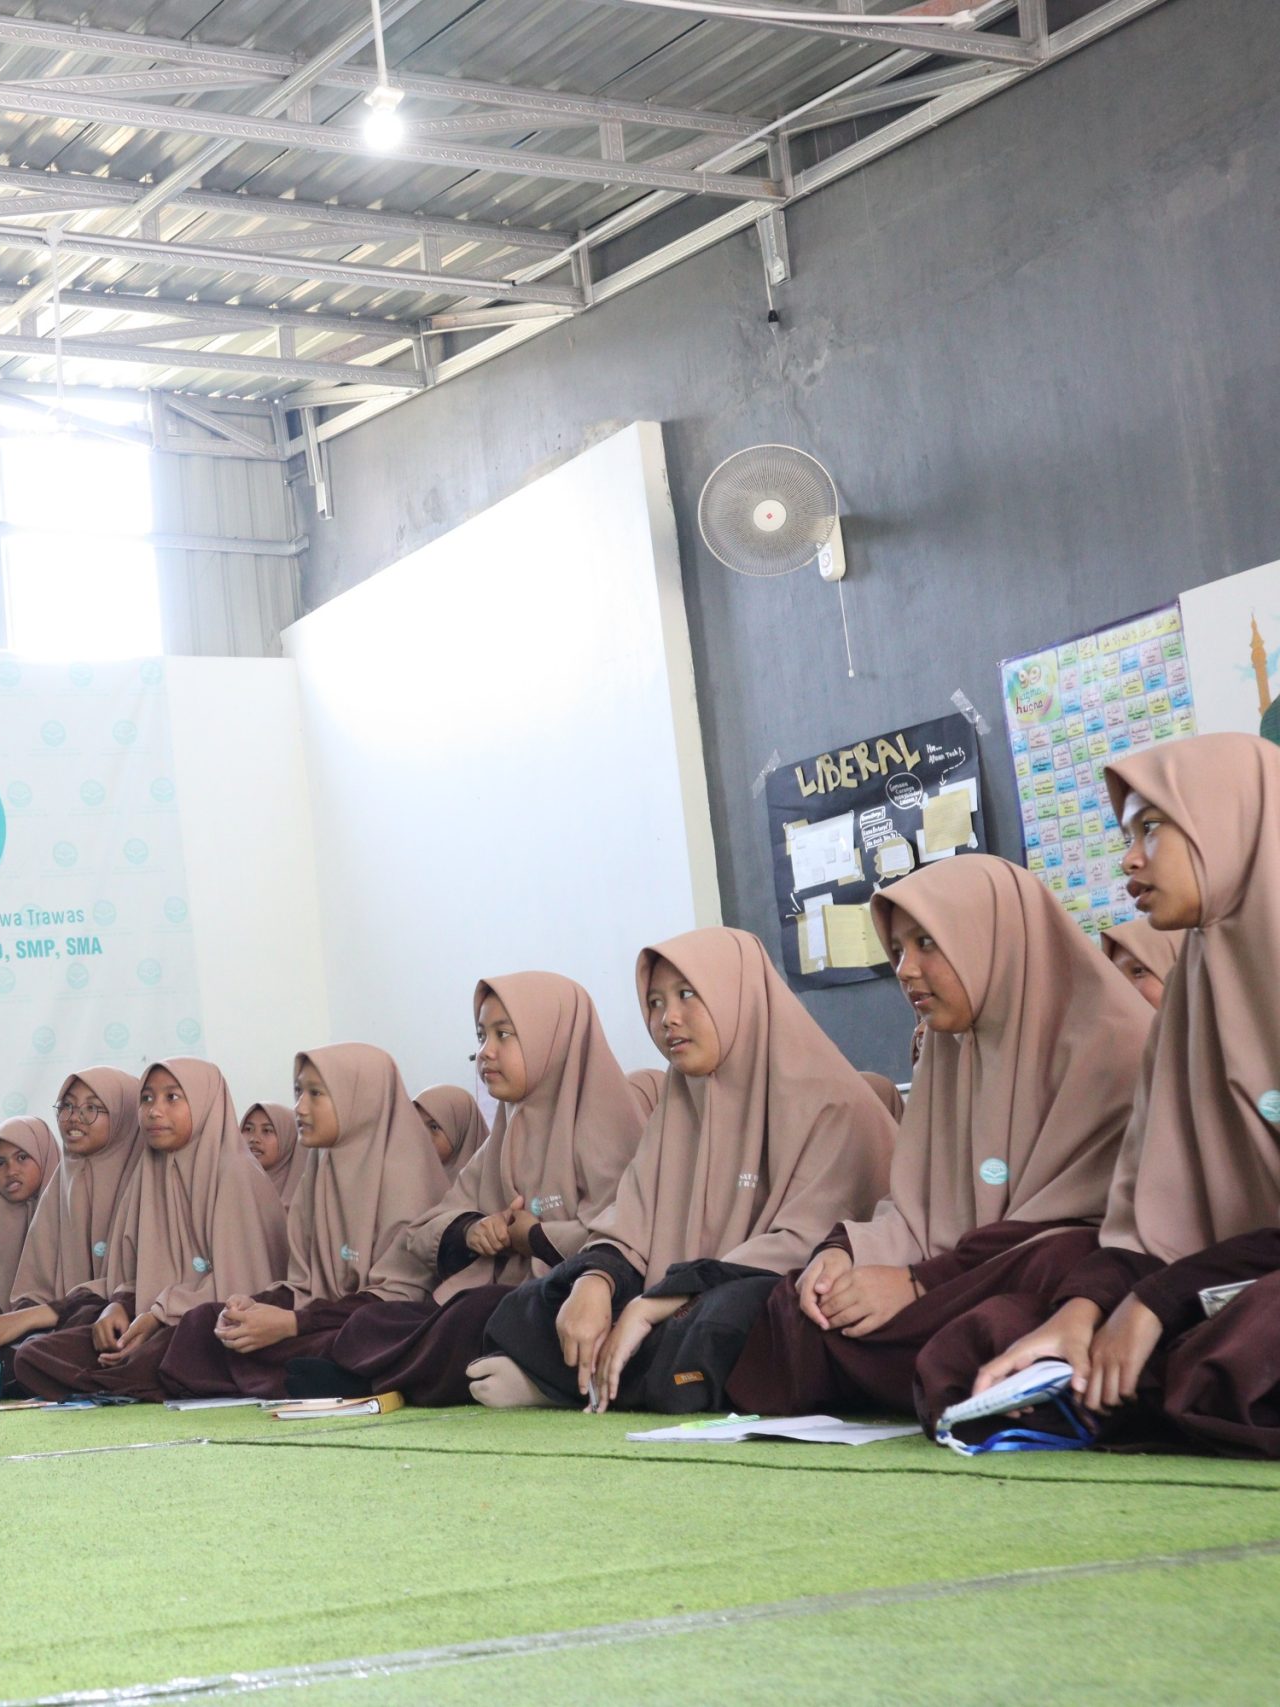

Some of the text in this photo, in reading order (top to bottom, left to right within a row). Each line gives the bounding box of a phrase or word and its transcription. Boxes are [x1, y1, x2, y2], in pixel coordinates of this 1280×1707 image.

[794, 733, 921, 797] LIBERAL
[26, 908, 85, 926] Trawas
[15, 939, 61, 960] SMP,
[66, 936, 103, 956] SMA
